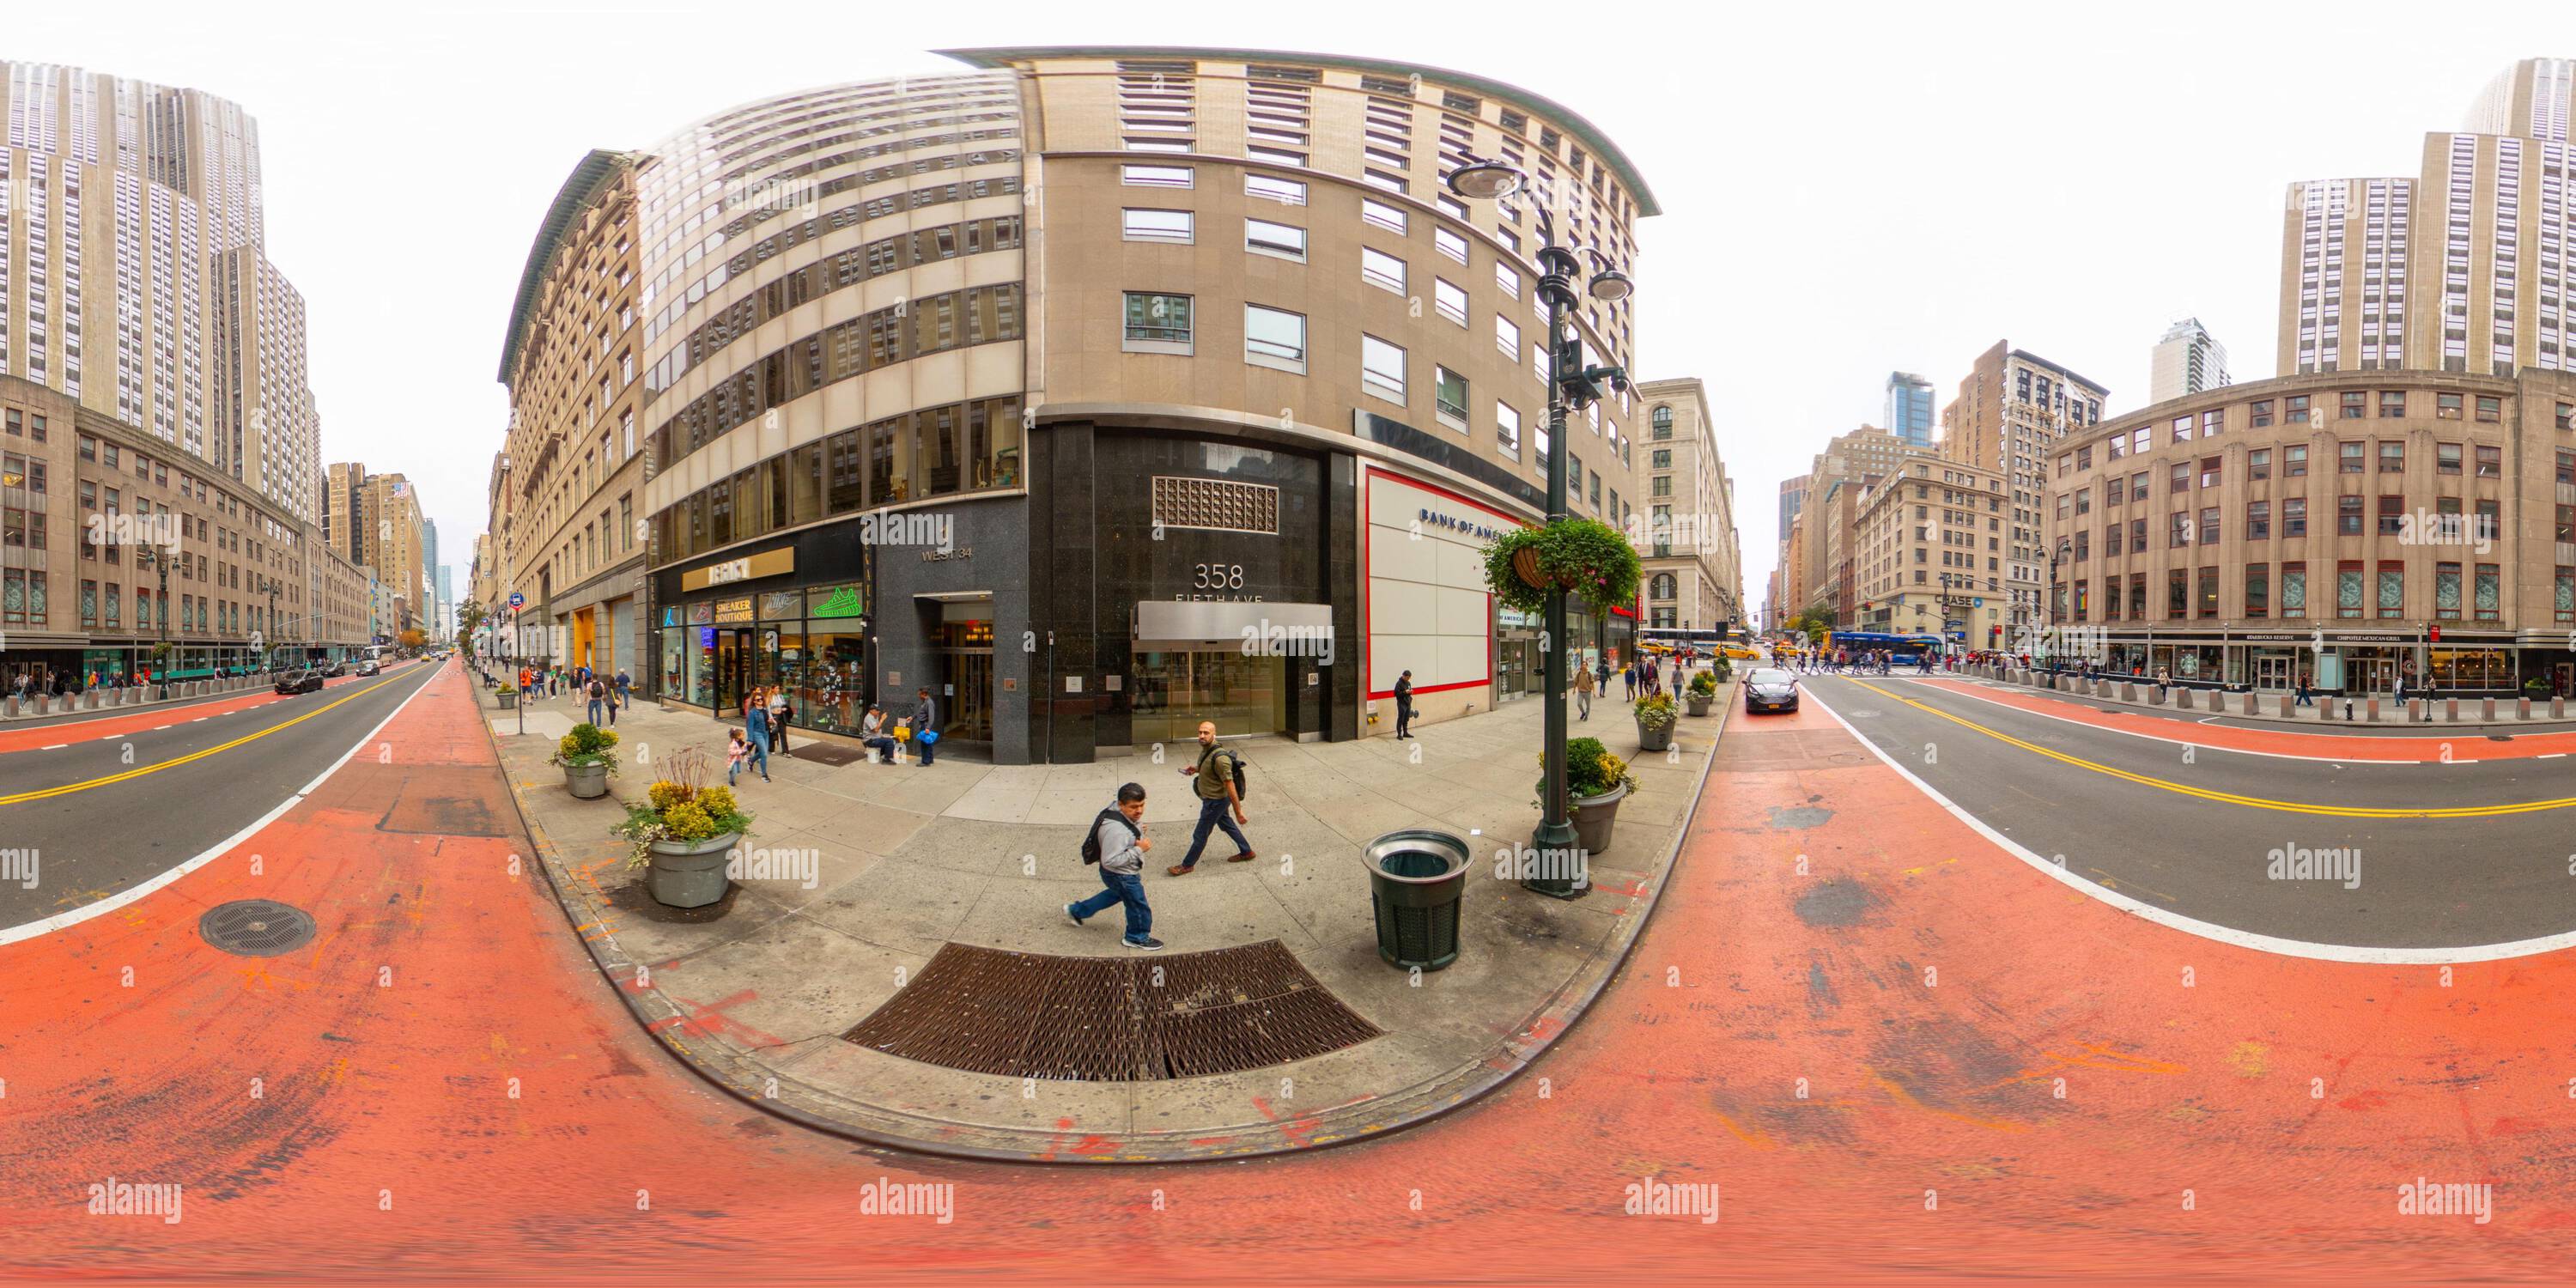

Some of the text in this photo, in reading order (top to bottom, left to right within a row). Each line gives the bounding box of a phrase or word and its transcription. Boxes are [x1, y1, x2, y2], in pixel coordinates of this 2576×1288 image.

[1419, 507, 1456, 530] BANK
[1457, 519, 1474, 534] OF
[921, 547, 973, 562] WEST 34
[1194, 563, 1243, 589] 358
[716, 599, 750, 612] SNEAKER
[769, 592, 791, 608] NIKE
[1176, 594, 1225, 603] FIFTH
[715, 611, 754, 623] BOUTIQUE
